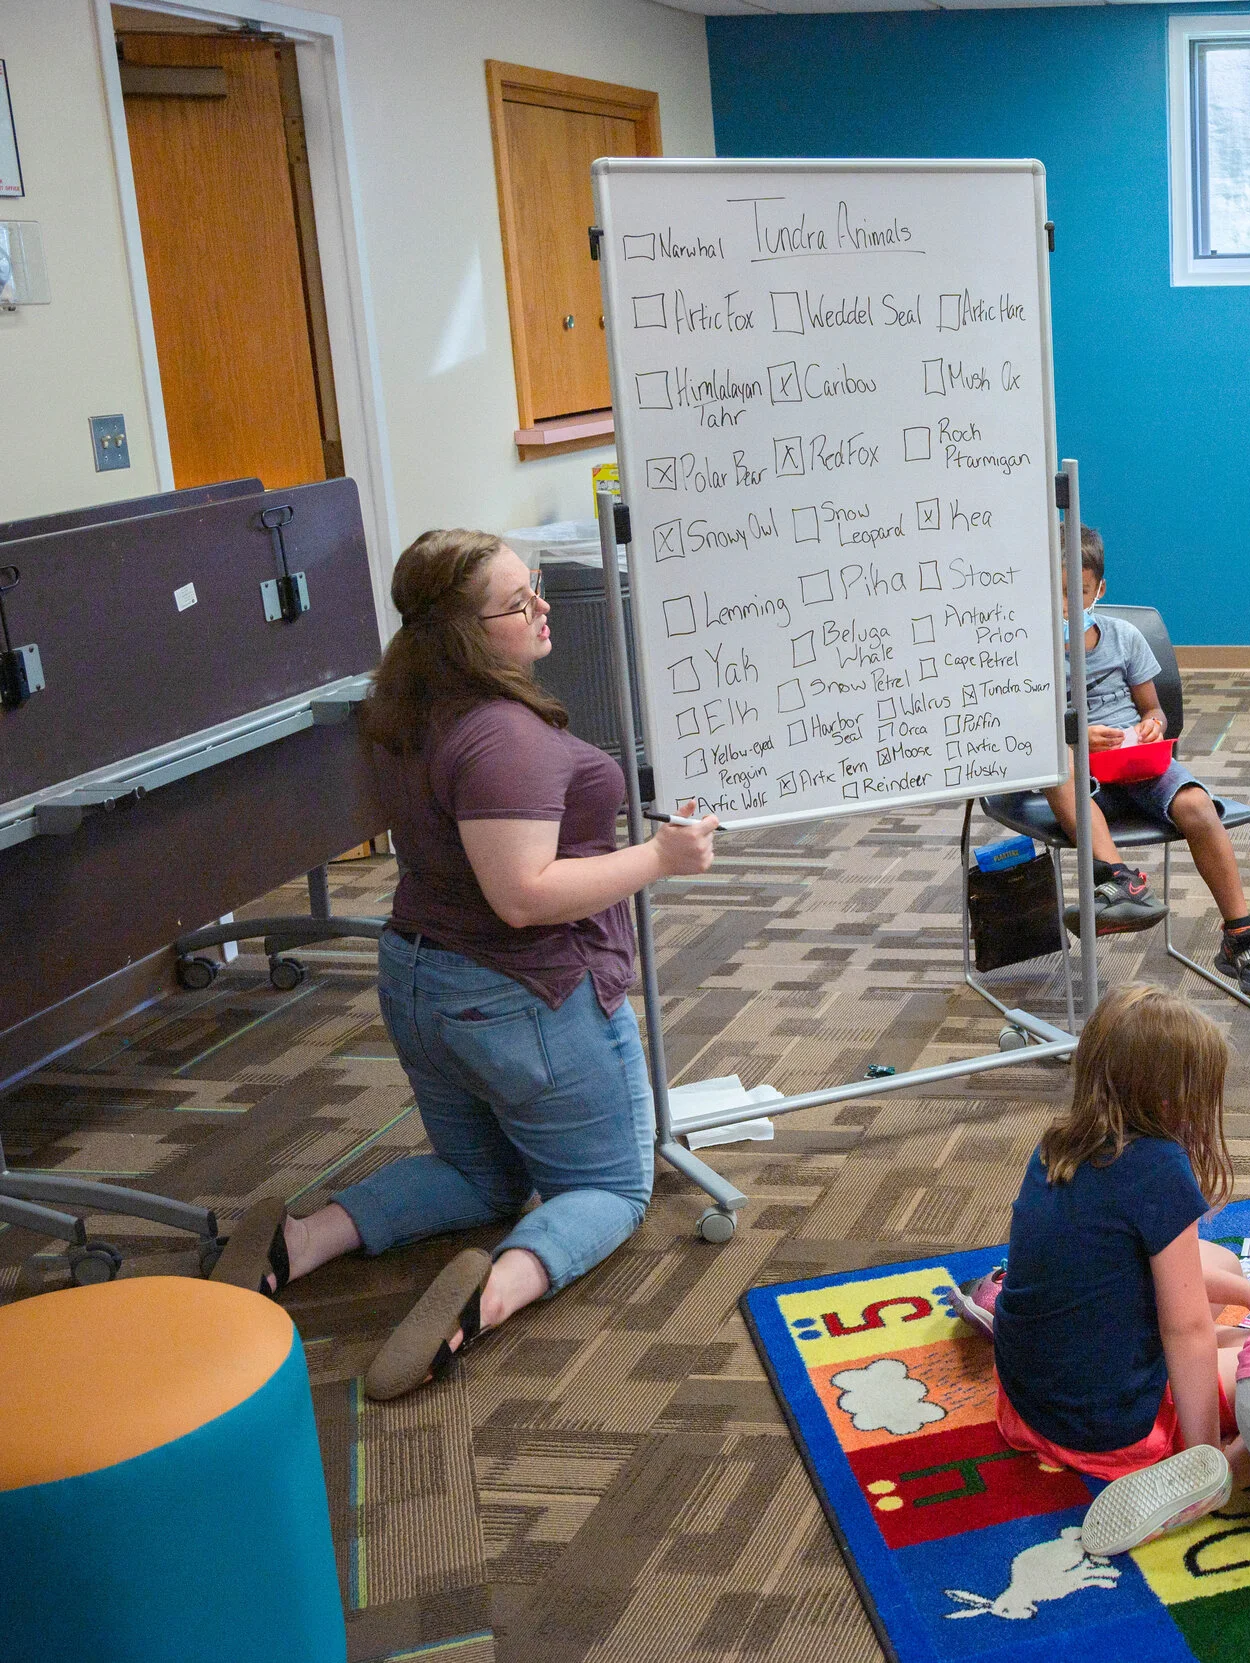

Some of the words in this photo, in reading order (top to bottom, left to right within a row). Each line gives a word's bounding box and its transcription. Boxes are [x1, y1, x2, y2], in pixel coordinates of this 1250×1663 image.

[726, 197, 828, 254] Tundra
[837, 200, 913, 250] Animals
[659, 226, 725, 259] Narwhal
[674, 288, 723, 335] Artic
[724, 290, 755, 332] Fox
[805, 289, 874, 328] Weddel
[882, 293, 922, 327] Seal
[962, 287, 997, 326] Artic
[999, 292, 1027, 323] Hare
[804, 362, 878, 399] Caribou
[1001, 360, 1021, 392] Ox
[693, 399, 747, 428] Tahr
[809, 434, 845, 471] Red
[847, 432, 880, 467] Fox
[945, 444, 1031, 476] Ptarmigan
[679, 452, 728, 493] Polar
[732, 449, 768, 487] Bear
[821, 500, 870, 523] Snow
[950, 498, 993, 532] Kea
[687, 519, 748, 553] Snowy
[748, 507, 779, 540] Owl
[838, 512, 906, 549] Leopard
[839, 562, 907, 600] Pika
[949, 557, 1022, 590] Stoat
[703, 590, 792, 629] Lemming
[944, 602, 1016, 628] Antartic
[822, 618, 891, 650] Beluga
[975, 625, 1029, 645] Prion
[704, 642, 759, 688] Yak
[836, 643, 894, 669] Whale
[943, 652, 977, 670] Cape
[978, 650, 1019, 669] Petrel
[810, 678, 867, 697] Snow
[870, 667, 911, 693] Petrel
[978, 678, 1022, 698] Tundra
[1023, 678, 1051, 694] Swan
[703, 697, 759, 735] Elk
[899, 692, 952, 716] Walrus
[811, 711, 864, 738] Harbor
[831, 726, 863, 746] Seal
[898, 721, 928, 737] Orca
[962, 711, 1001, 733] Puffin
[892, 741, 933, 761] Moose
[966, 737, 1001, 754] Artic
[1005, 735, 1033, 756] Dog
[718, 764, 768, 789] Penguin
[838, 757, 869, 778] Tern
[863, 771, 933, 794] Reindeer
[965, 759, 1008, 781] Husky
[697, 794, 738, 814] Artic
[741, 788, 769, 810] Wolf
[820, 1296, 934, 1338] 5
